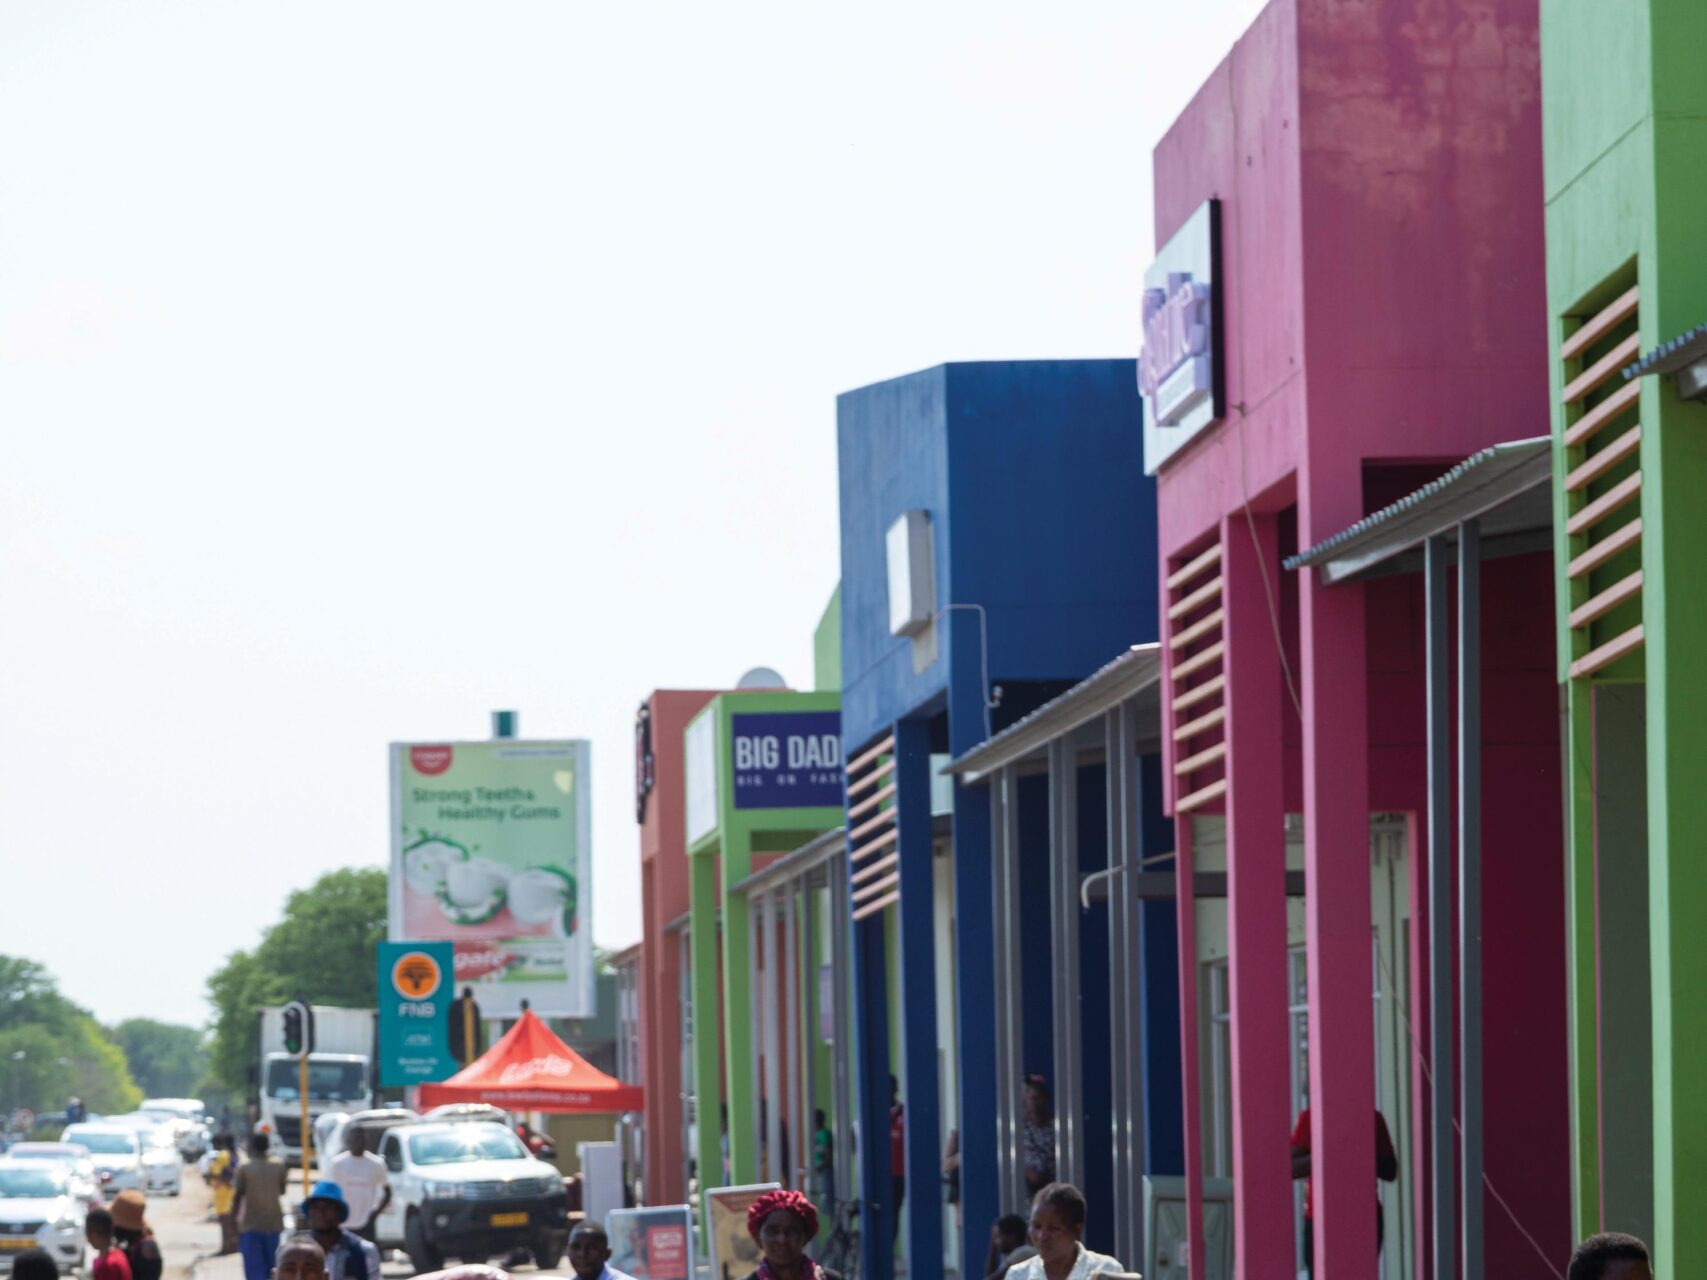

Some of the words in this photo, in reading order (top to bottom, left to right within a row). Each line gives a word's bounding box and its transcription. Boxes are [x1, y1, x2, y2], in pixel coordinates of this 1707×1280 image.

[735, 735, 780, 770] BIG
[787, 734, 843, 769] DAD
[412, 787, 473, 804] Strong
[438, 807, 506, 823] Healthy
[510, 806, 561, 819] Gums
[455, 950, 501, 970] gate
[398, 1002, 436, 1018] FNB
